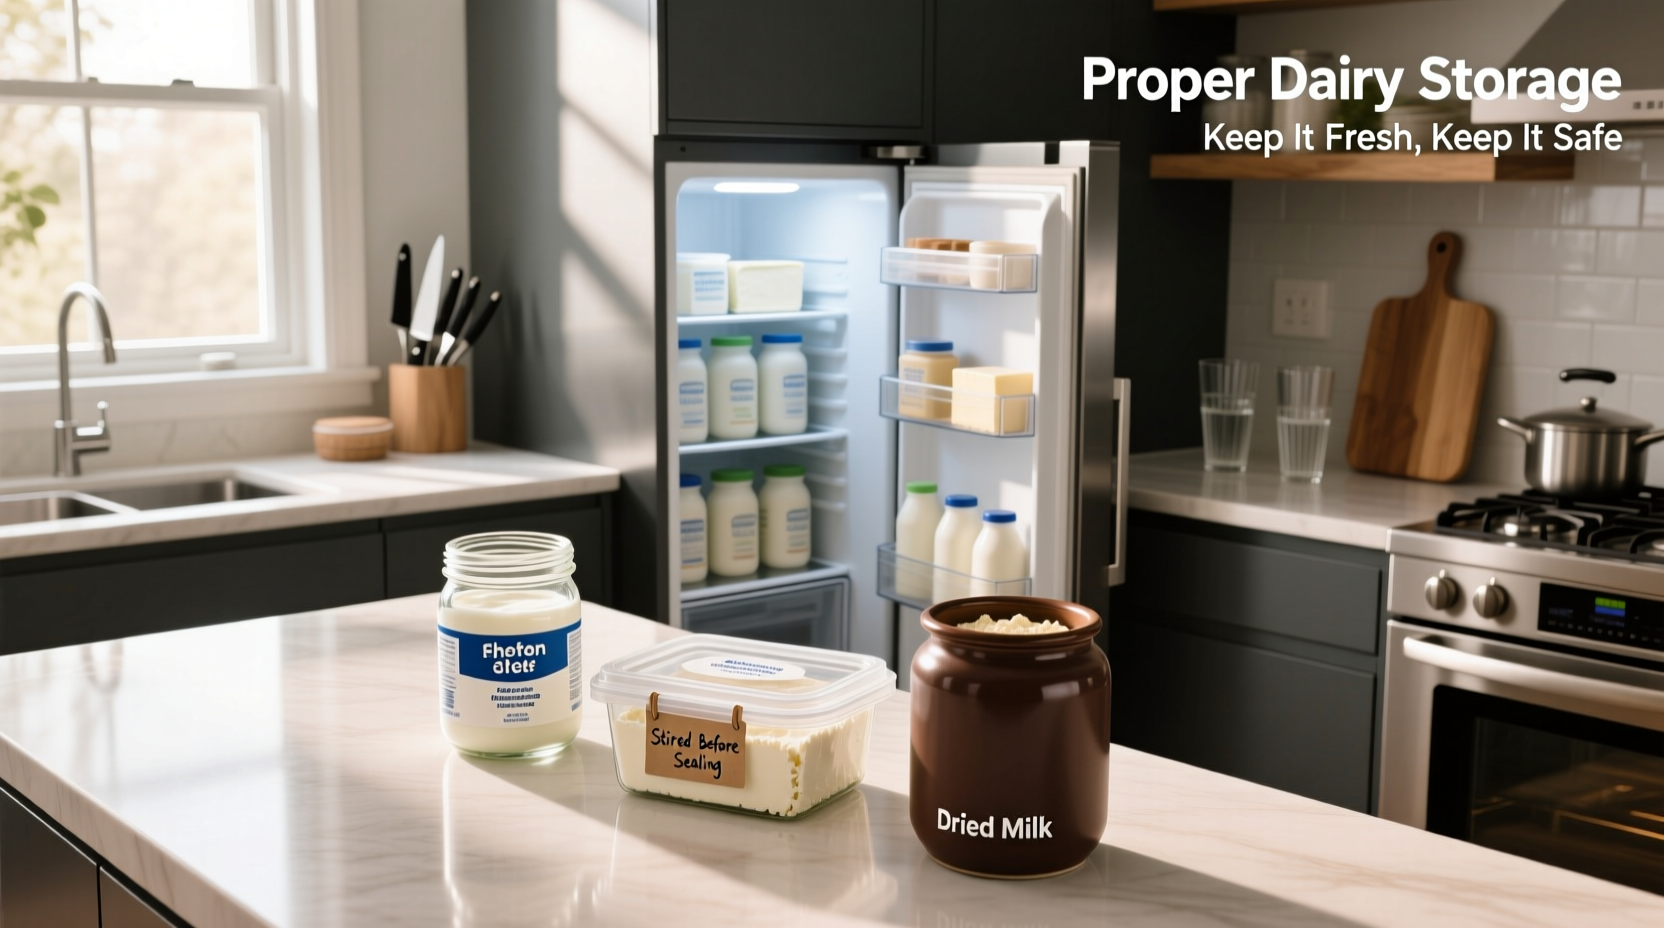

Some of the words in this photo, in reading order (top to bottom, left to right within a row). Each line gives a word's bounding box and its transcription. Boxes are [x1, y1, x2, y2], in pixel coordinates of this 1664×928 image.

[650, 727, 691, 749] Stired
[699, 733, 739, 753] Before
[673, 752, 722, 779] Sealing
[937, 807, 994, 838] Dried
[1002, 815, 1053, 839] Milk
